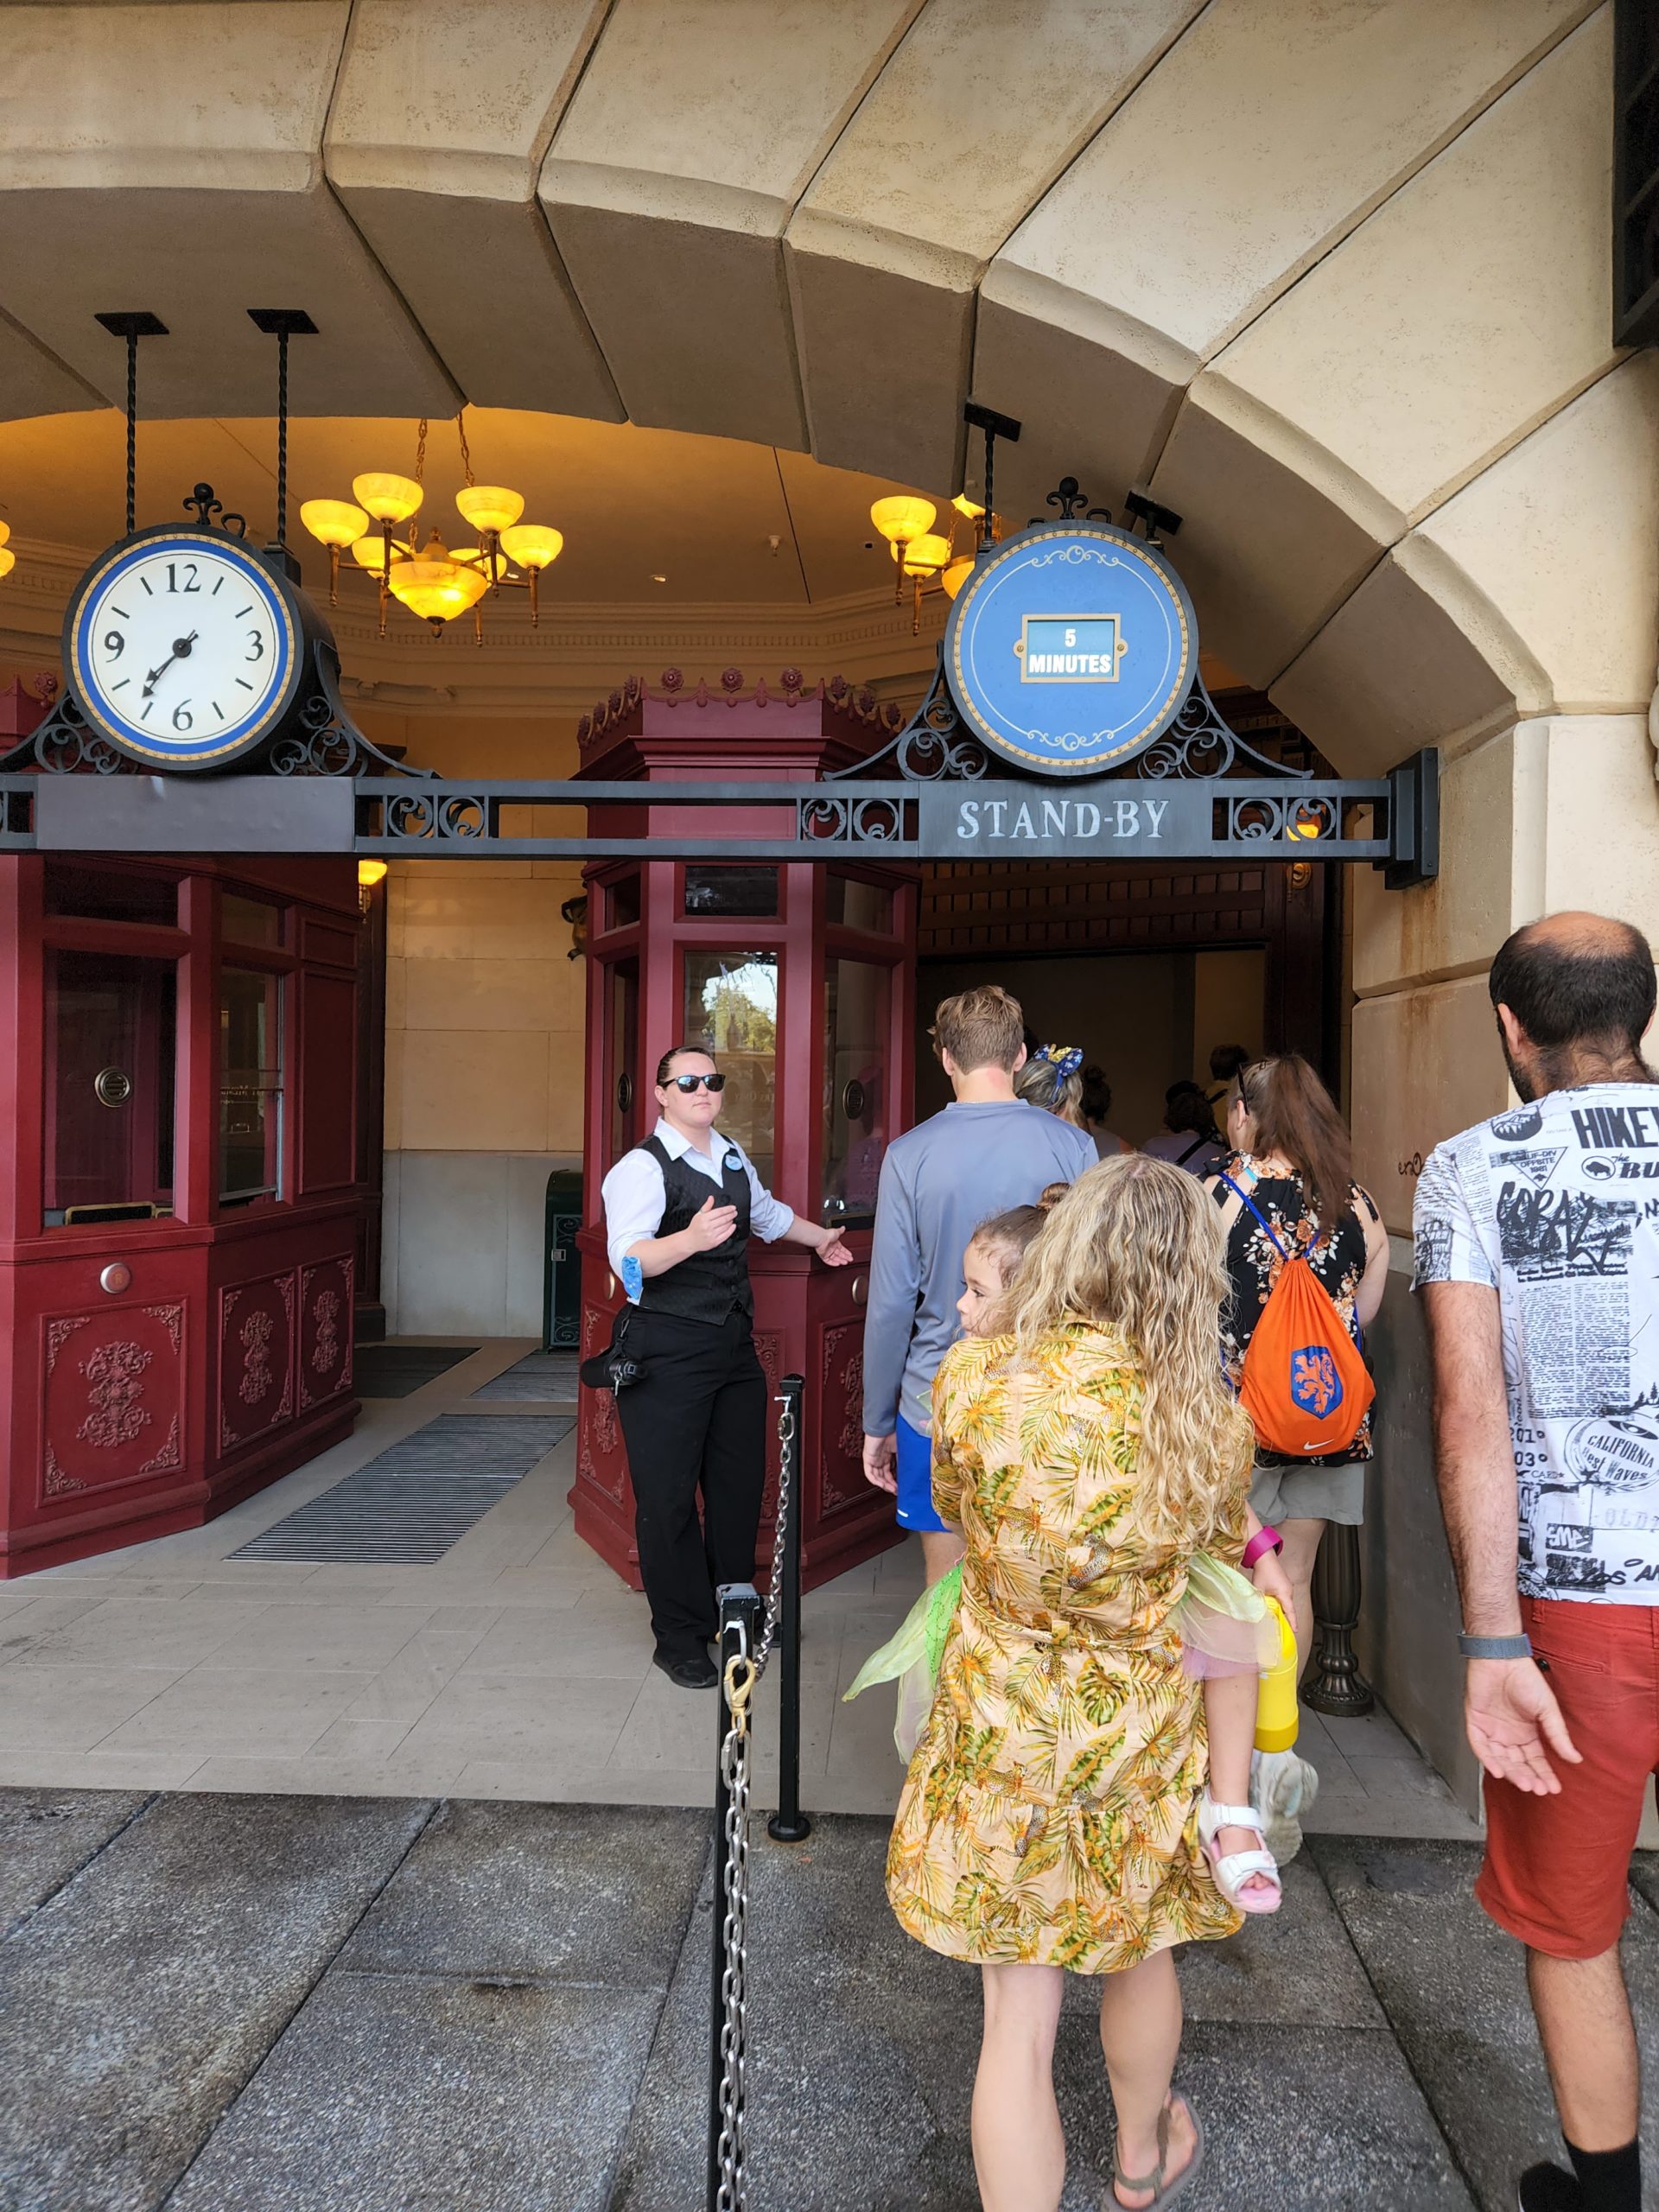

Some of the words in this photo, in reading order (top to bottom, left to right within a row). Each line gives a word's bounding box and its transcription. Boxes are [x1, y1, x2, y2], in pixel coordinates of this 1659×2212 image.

[166, 563, 201, 594] 12
[104, 630, 125, 664] 9
[244, 630, 264, 662] 3
[1064, 628, 1077, 648] 5
[1028, 654, 1112, 675] MINUTES
[172, 698, 194, 732] 6
[957, 799, 1170, 840] STAND-BY
[1587, 1434, 1655, 1468] CALIFORNIA
[1605, 1459, 1649, 1481] Waves
